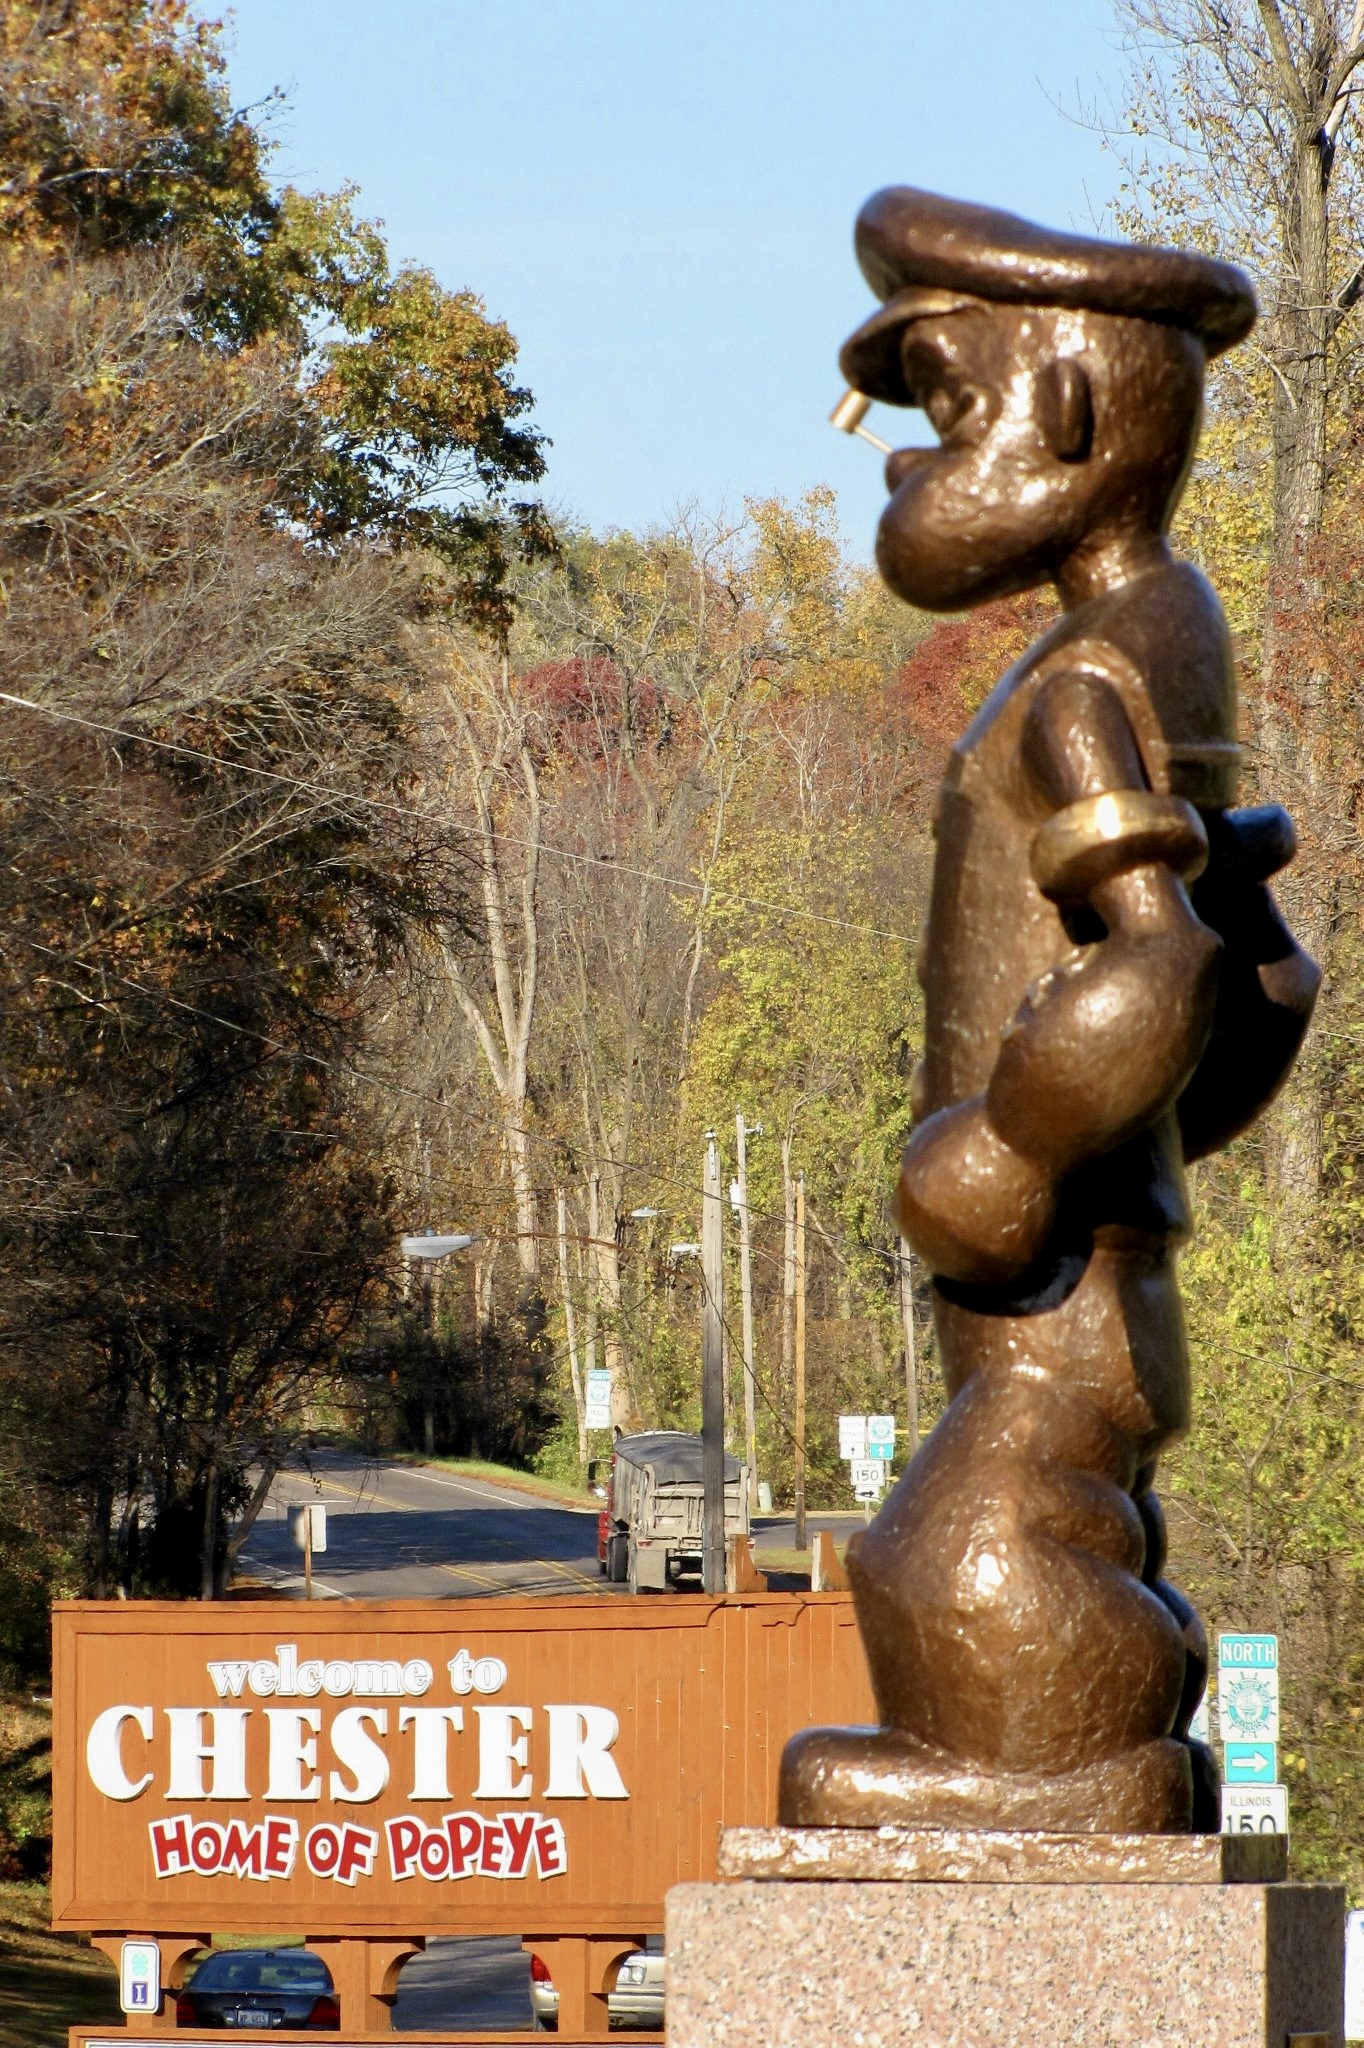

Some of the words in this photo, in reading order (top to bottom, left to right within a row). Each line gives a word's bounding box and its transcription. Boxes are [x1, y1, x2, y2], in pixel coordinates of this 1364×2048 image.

[856, 1469, 879, 1482] 150
[207, 1644, 434, 1698] welcome
[447, 1648, 508, 1695] to
[1221, 1642, 1275, 1663] NORTH
[86, 1705, 631, 1803] CHESTER
[1230, 1796, 1272, 1807] ILLINOIS
[149, 1815, 299, 1881] HOME
[305, 1822, 379, 1887] OF
[384, 1811, 568, 1881] POPEYE
